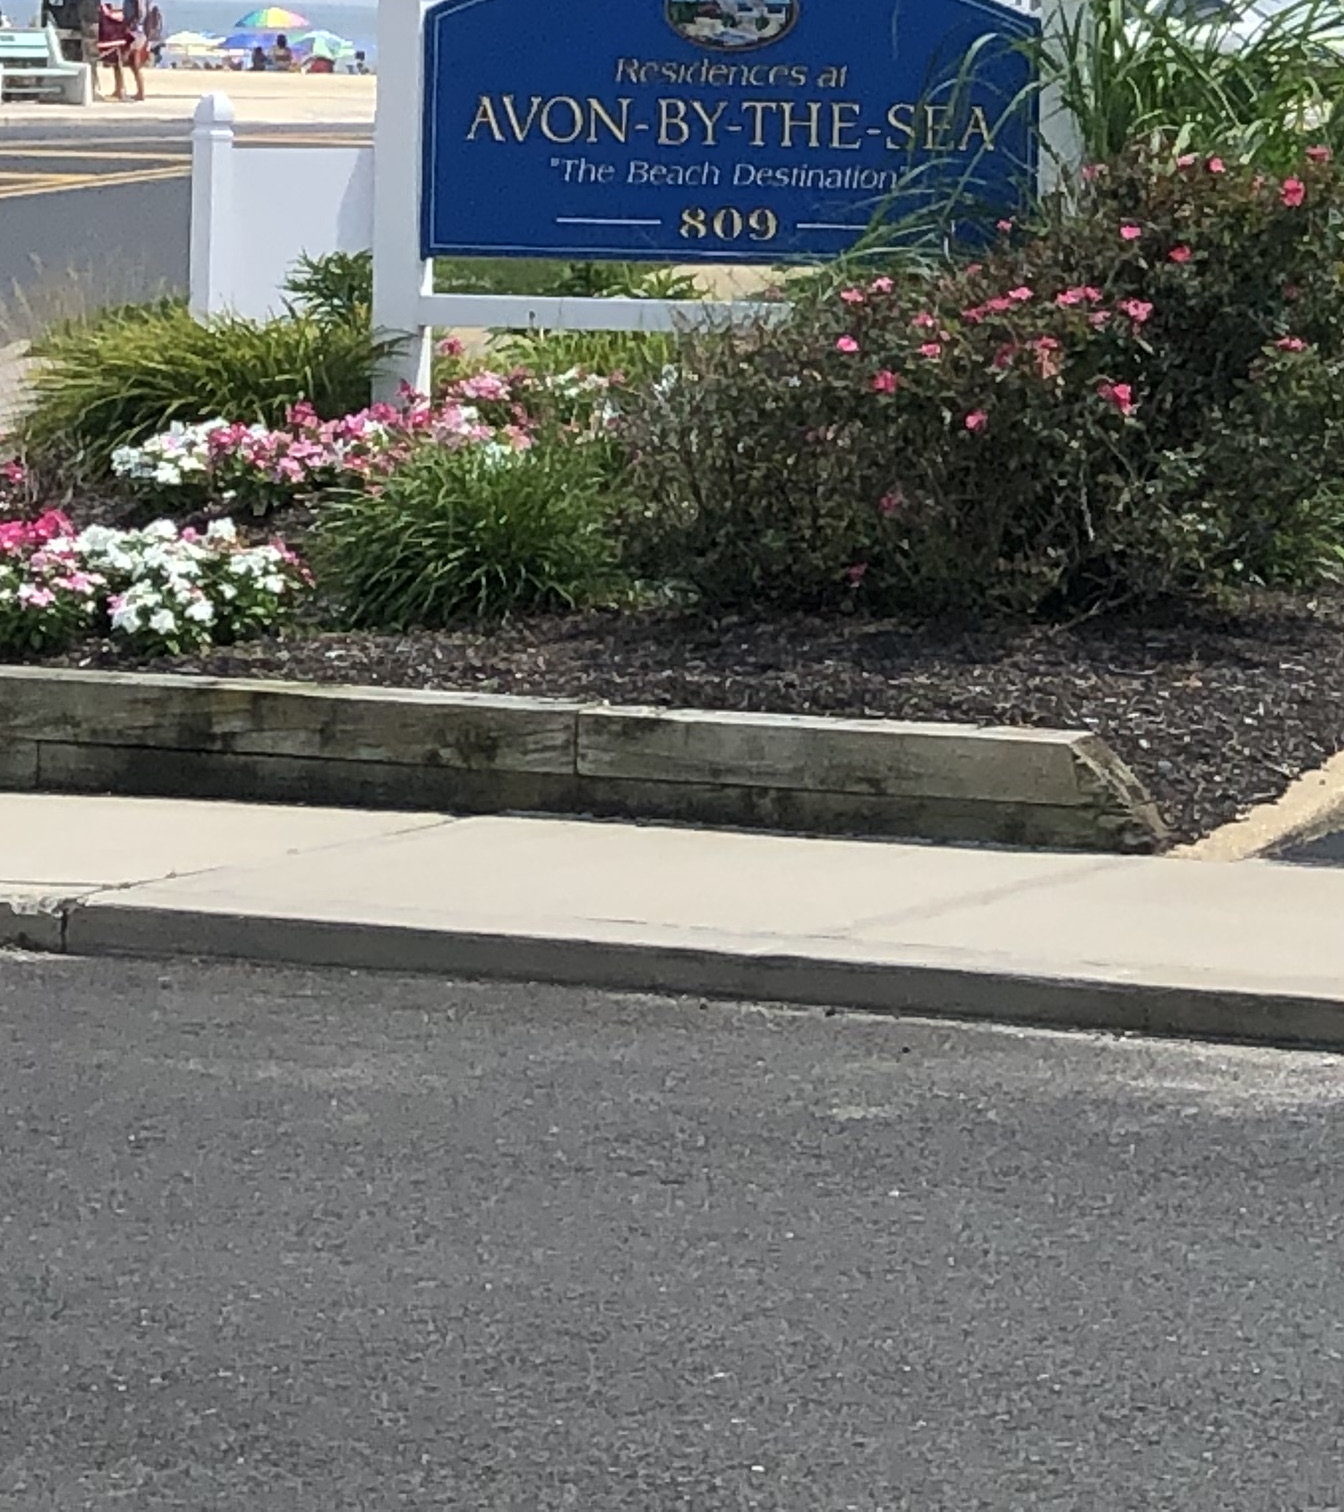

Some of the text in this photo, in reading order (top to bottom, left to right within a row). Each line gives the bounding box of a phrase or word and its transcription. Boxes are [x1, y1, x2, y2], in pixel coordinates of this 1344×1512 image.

[615, 57, 848, 88] Residences at
[465, 95, 996, 151] AVON-BY-THE-SEA
[626, 160, 721, 186] Beach
[679, 207, 778, 241] 809
